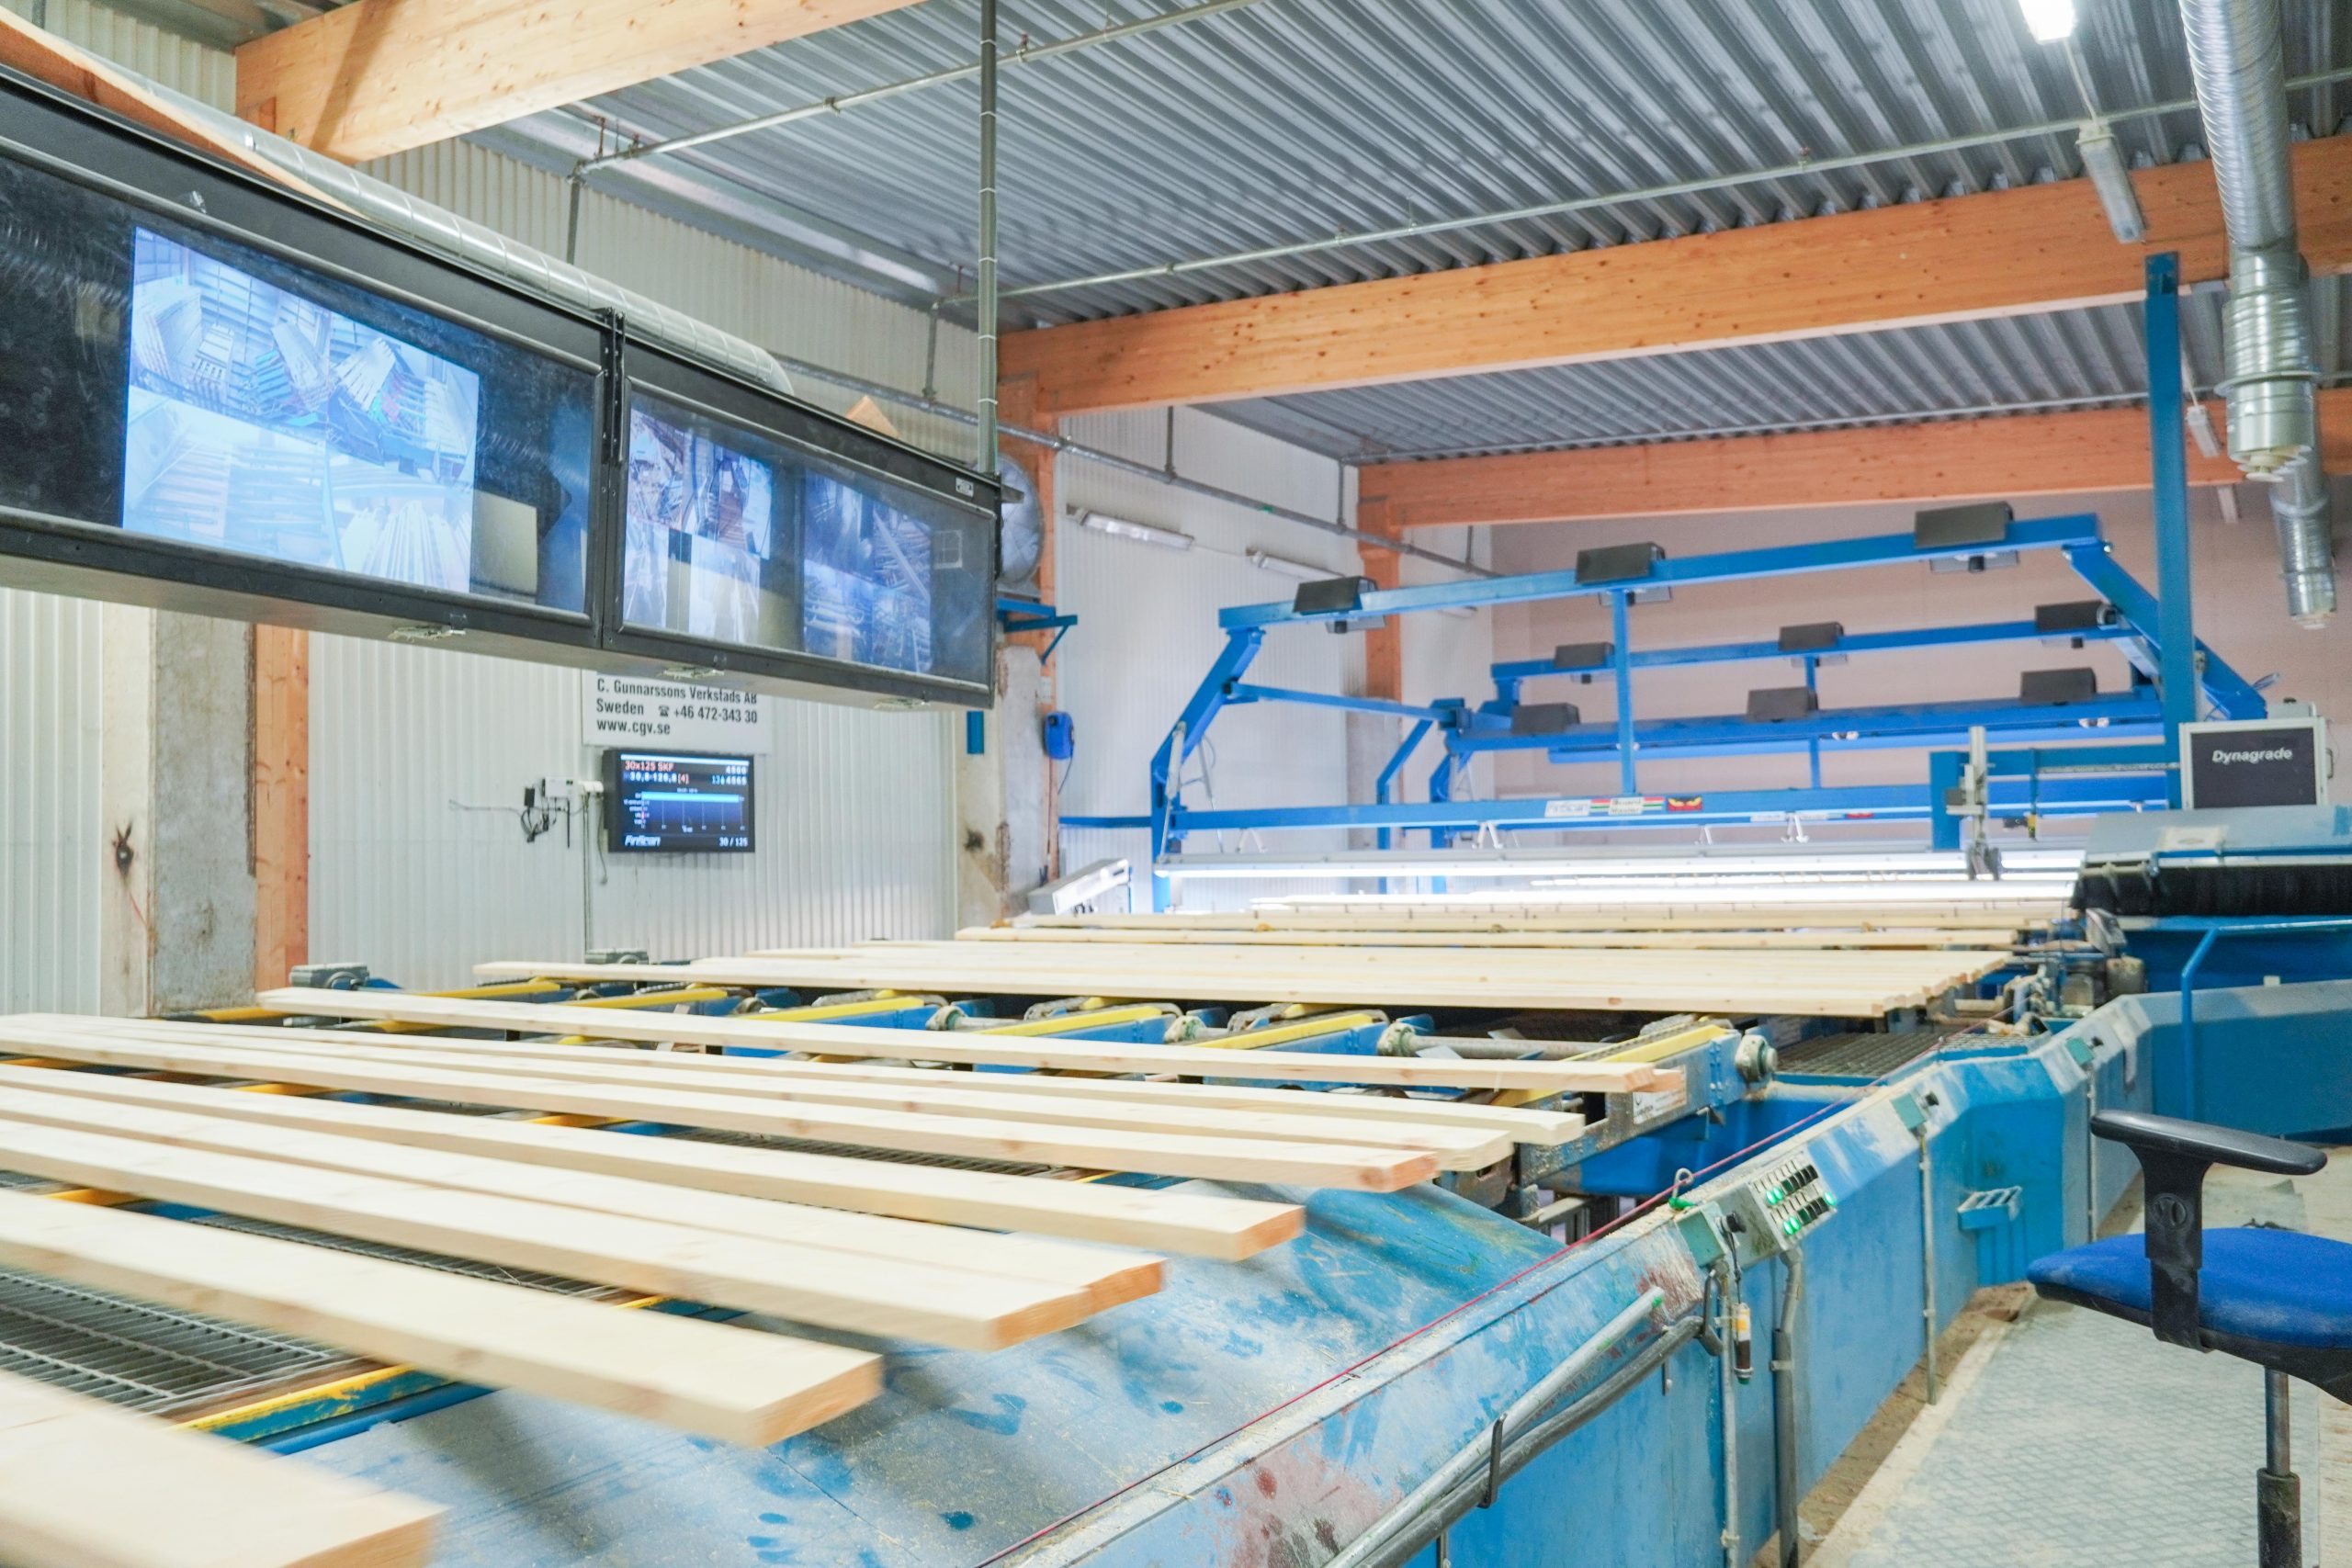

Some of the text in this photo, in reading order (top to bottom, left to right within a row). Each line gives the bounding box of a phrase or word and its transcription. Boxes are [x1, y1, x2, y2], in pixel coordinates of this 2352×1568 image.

[597, 678, 757, 705] C. Gunnarssons Verkstads AB
[596, 698, 758, 724] Sweden +46 472-343 30
[596, 719, 671, 736] www.cgv.se
[2211, 747, 2293, 766] Dynagrade
